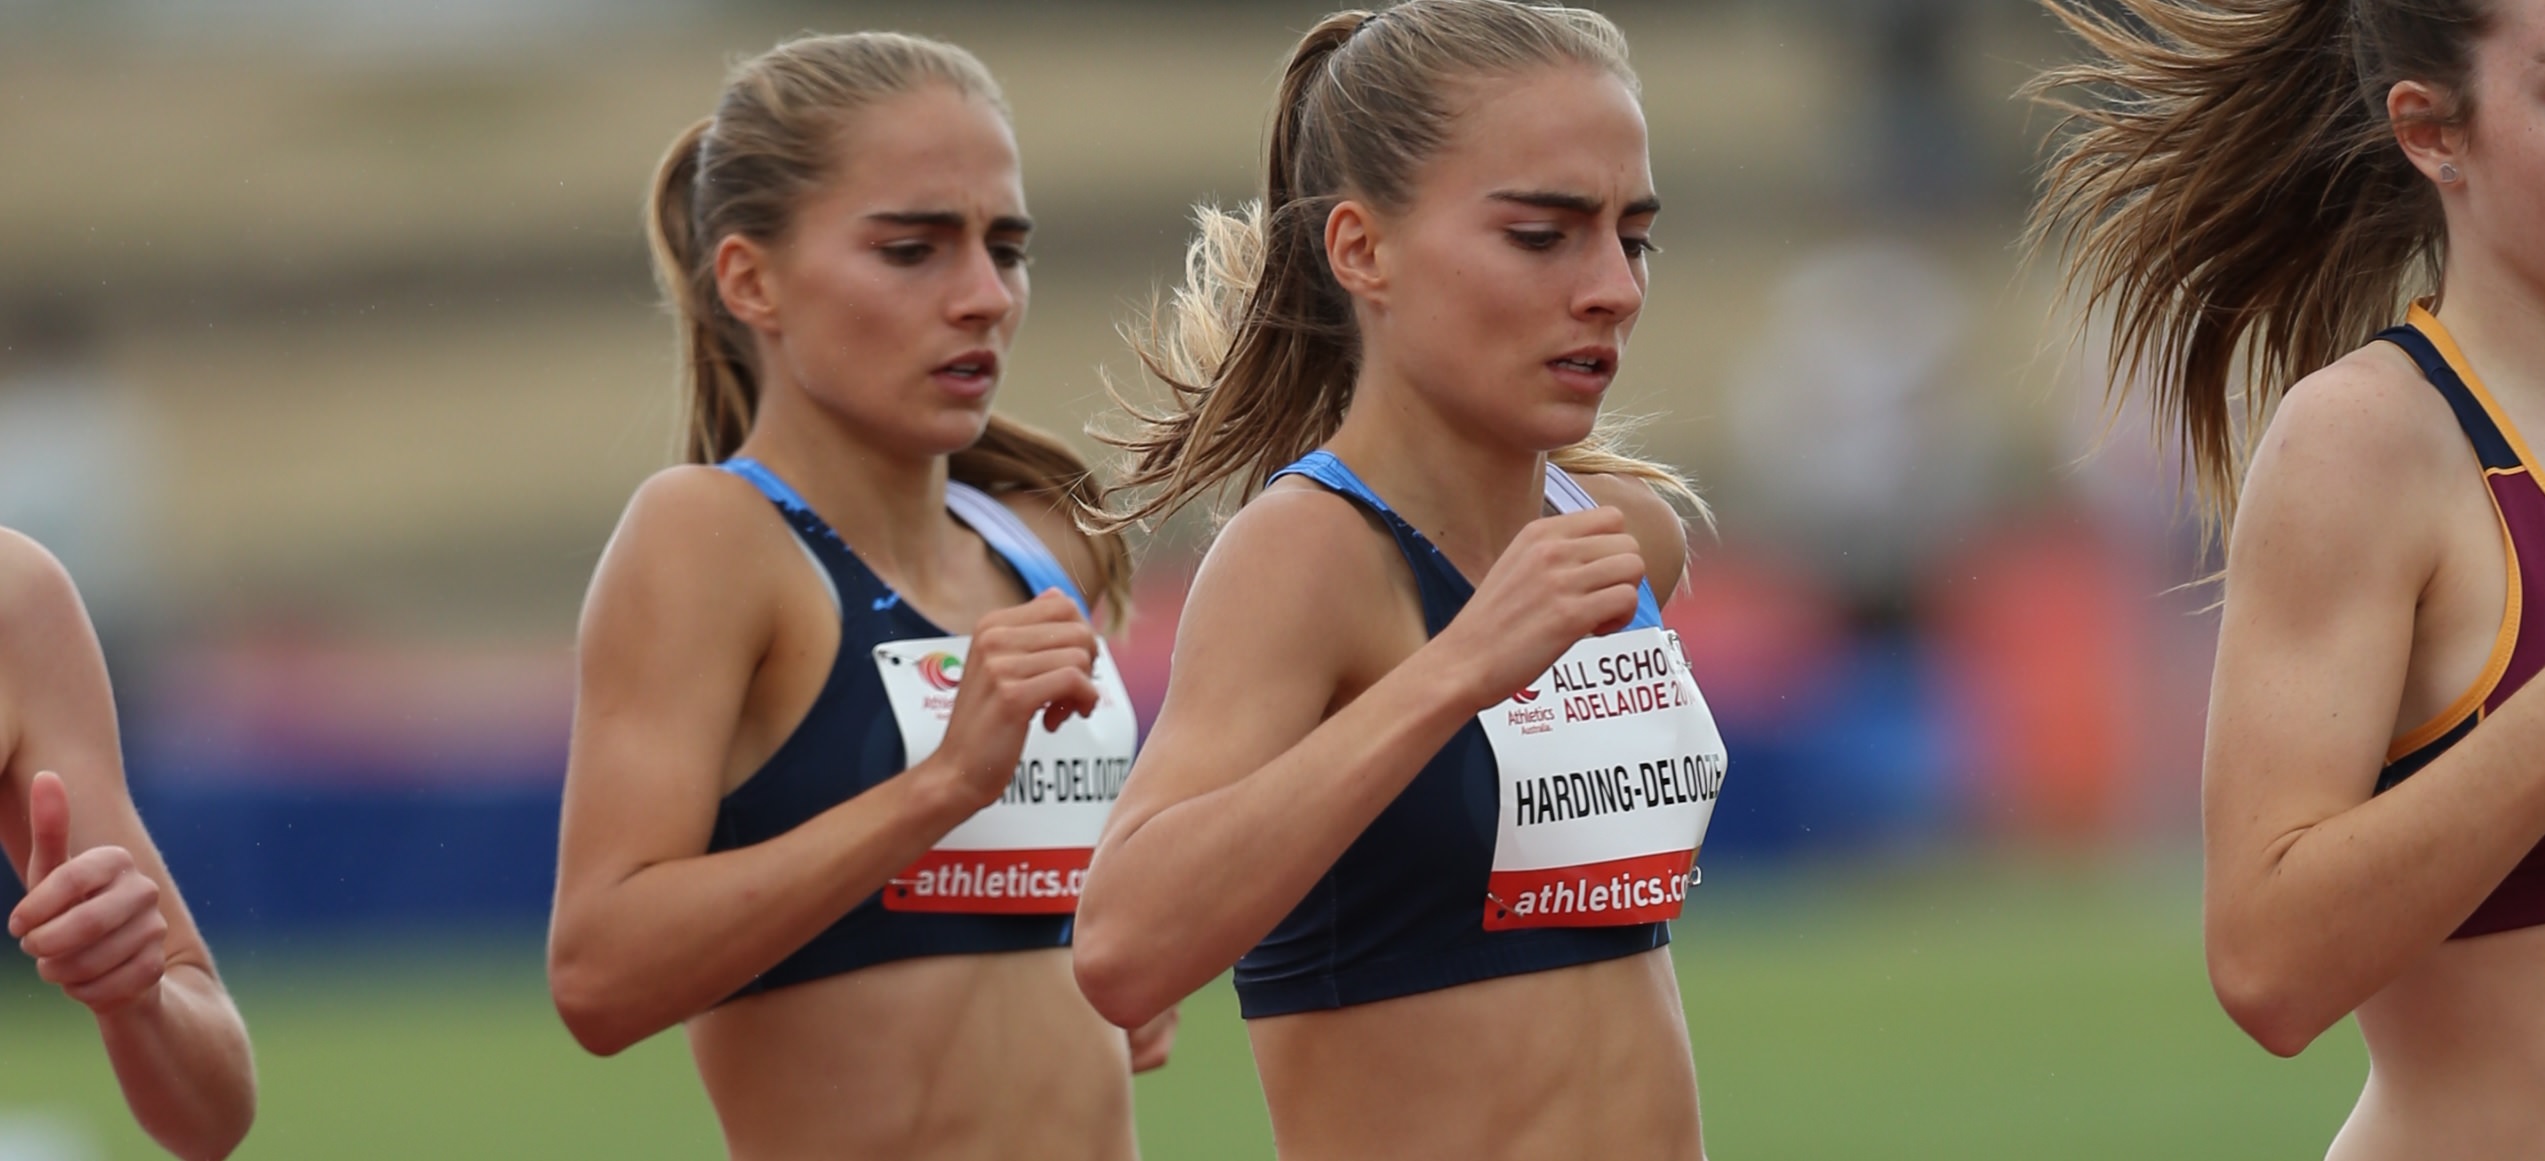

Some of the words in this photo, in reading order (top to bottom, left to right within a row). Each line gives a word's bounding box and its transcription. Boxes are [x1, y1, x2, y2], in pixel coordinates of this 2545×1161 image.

[1552, 661, 1598, 693] ALL
[1508, 707, 1555, 726] Athletics
[1563, 682, 1670, 723] ADELAIDE
